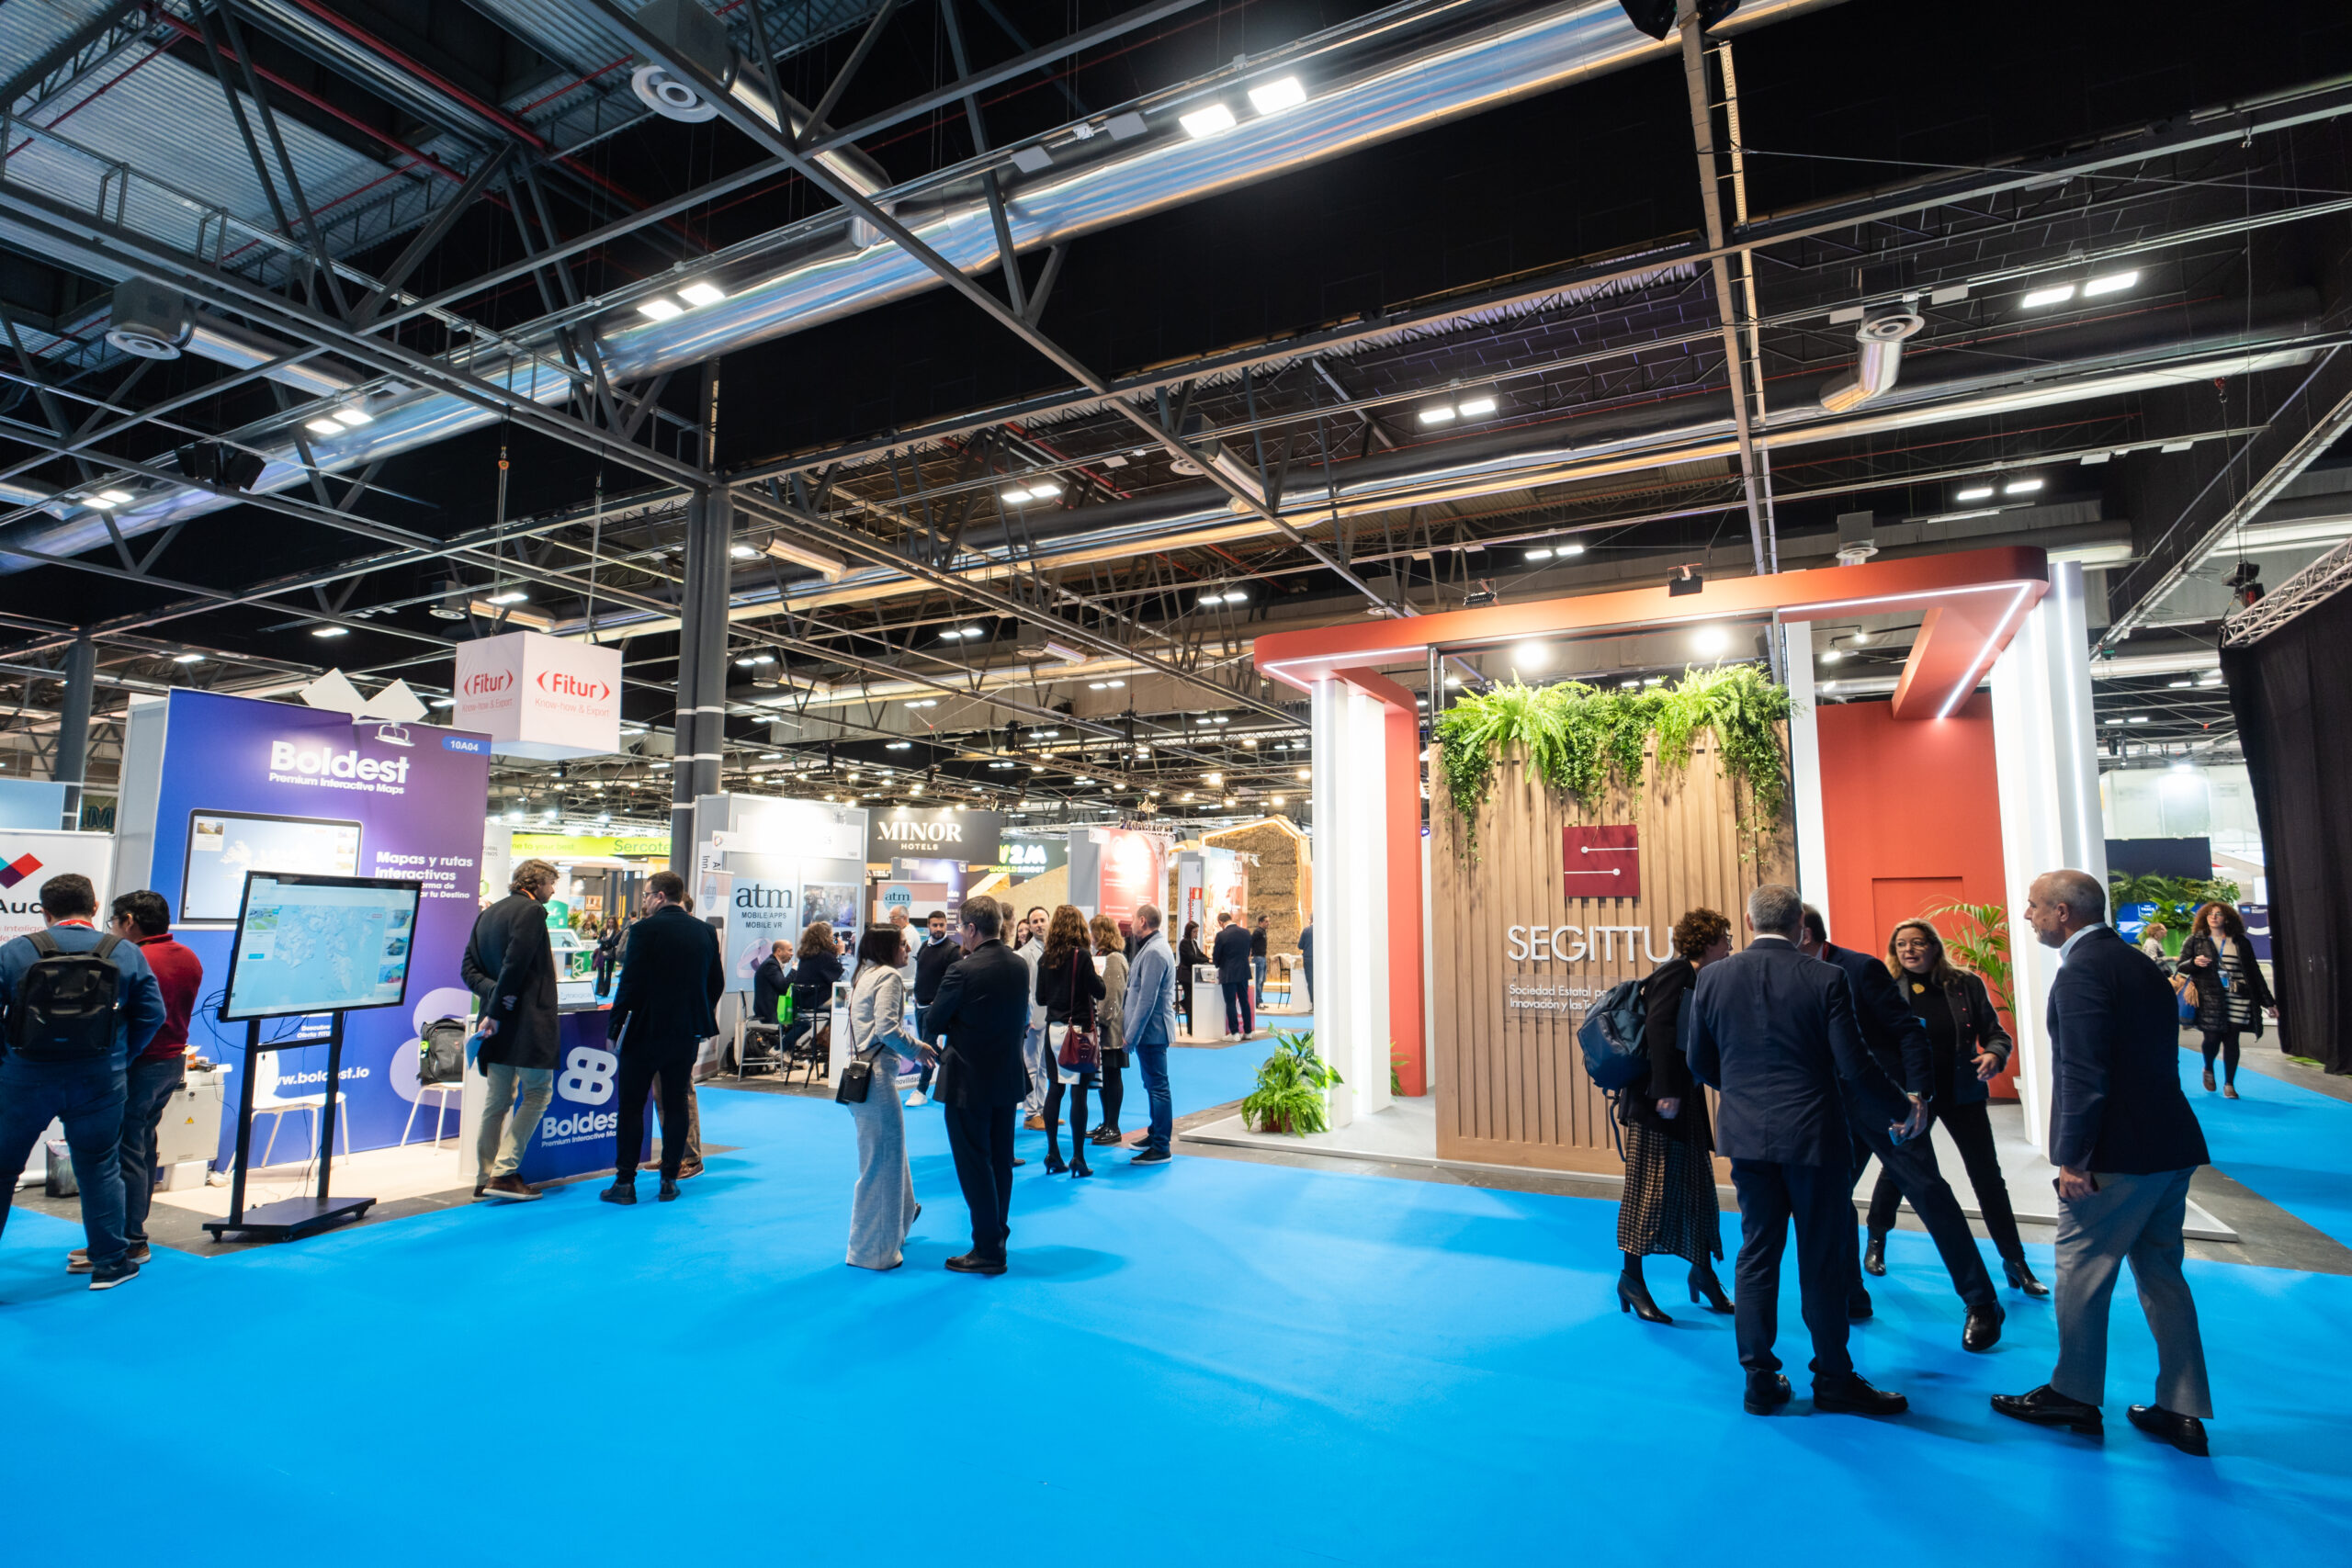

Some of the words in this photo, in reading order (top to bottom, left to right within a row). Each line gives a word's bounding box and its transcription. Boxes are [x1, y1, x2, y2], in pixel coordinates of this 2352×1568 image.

[473, 672, 503, 694] Fitur
[552, 672, 597, 698] Fitur
[462, 701, 489, 714] Know-how
[495, 698, 513, 709] Export
[535, 698, 577, 713] Know-how
[579, 705, 585, 714] &
[586, 706, 610, 718] Export
[451, 740, 478, 751] 10A04
[270, 740, 410, 784] Boldest
[269, 773, 318, 785] Premium
[321, 778, 374, 792] Interactive
[377, 784, 404, 795] Maps
[877, 821, 963, 842] MINOR
[614, 839, 669, 852] Sercote
[900, 842, 939, 851] HOTELS
[376, 851, 425, 866] Mapas
[428, 857, 437, 867] y
[440, 856, 474, 867] rutas
[374, 866, 457, 881] Interactivas
[736, 884, 794, 908] atm
[885, 892, 910, 901] atm
[1508, 925, 1675, 964] SEGITTU
[1509, 985, 1555, 997] Sociedad
[1558, 986, 1591, 998] Estatal
[1595, 988, 1608, 999] pa
[1510, 998, 1559, 1010] Innovación
[1561, 1002, 1567, 1013] y
[1569, 999, 1582, 1010] las
[1583, 999, 1592, 1010] Te
[542, 1111, 617, 1139] Boldes
[541, 1137, 571, 1147] Premium
[571, 1132, 605, 1144] Interactive
[605, 1130, 617, 1138] Ma
